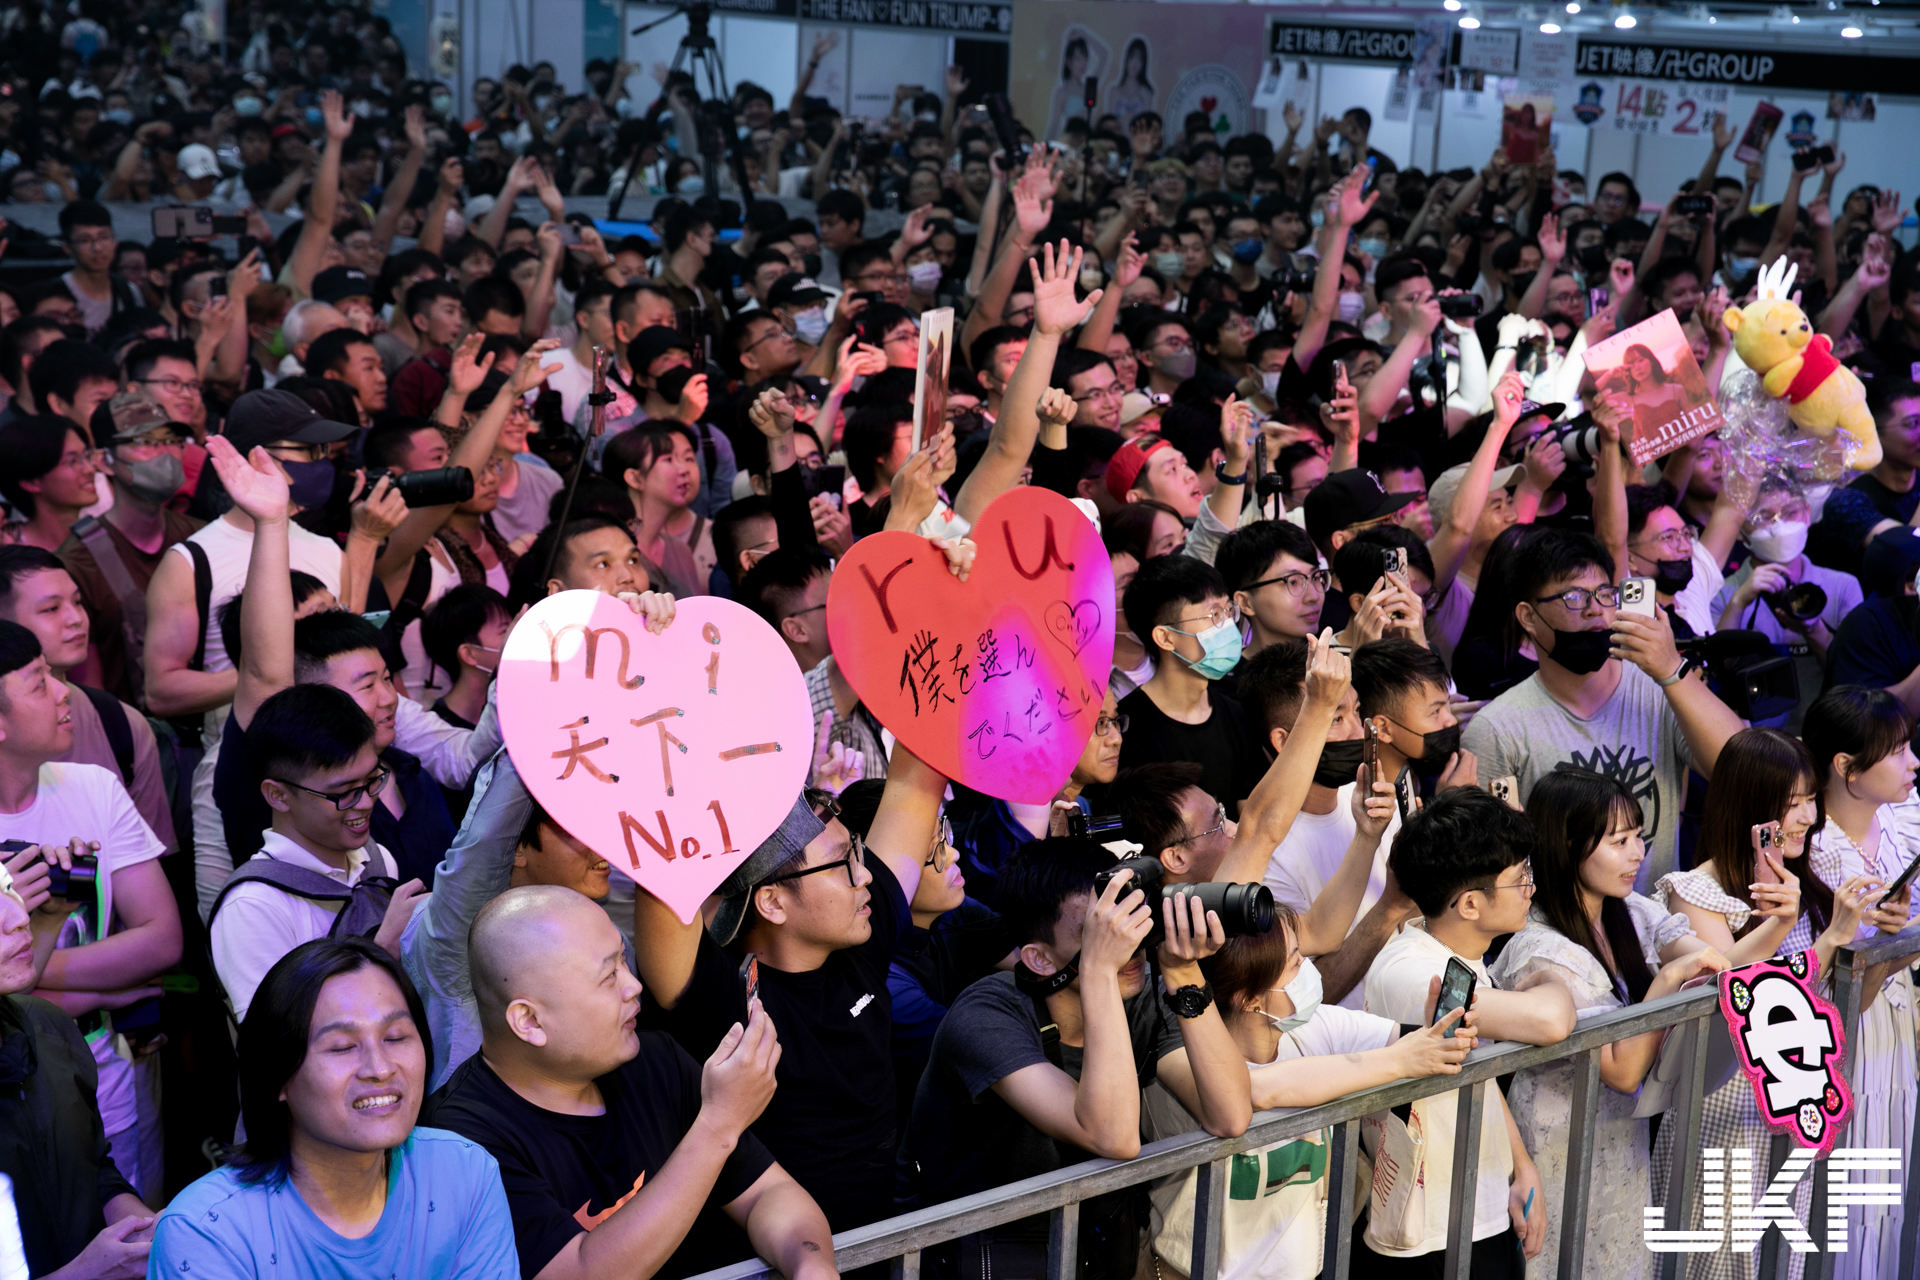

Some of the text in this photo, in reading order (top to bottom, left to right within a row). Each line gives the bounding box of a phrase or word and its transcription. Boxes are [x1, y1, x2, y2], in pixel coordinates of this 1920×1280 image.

[1658, 402, 1717, 441] miru
[900, 629, 1036, 717] 僕を選ん
[550, 707, 783, 797] 天下一
[968, 679, 1105, 760] でください
[618, 800, 741, 870] No.1
